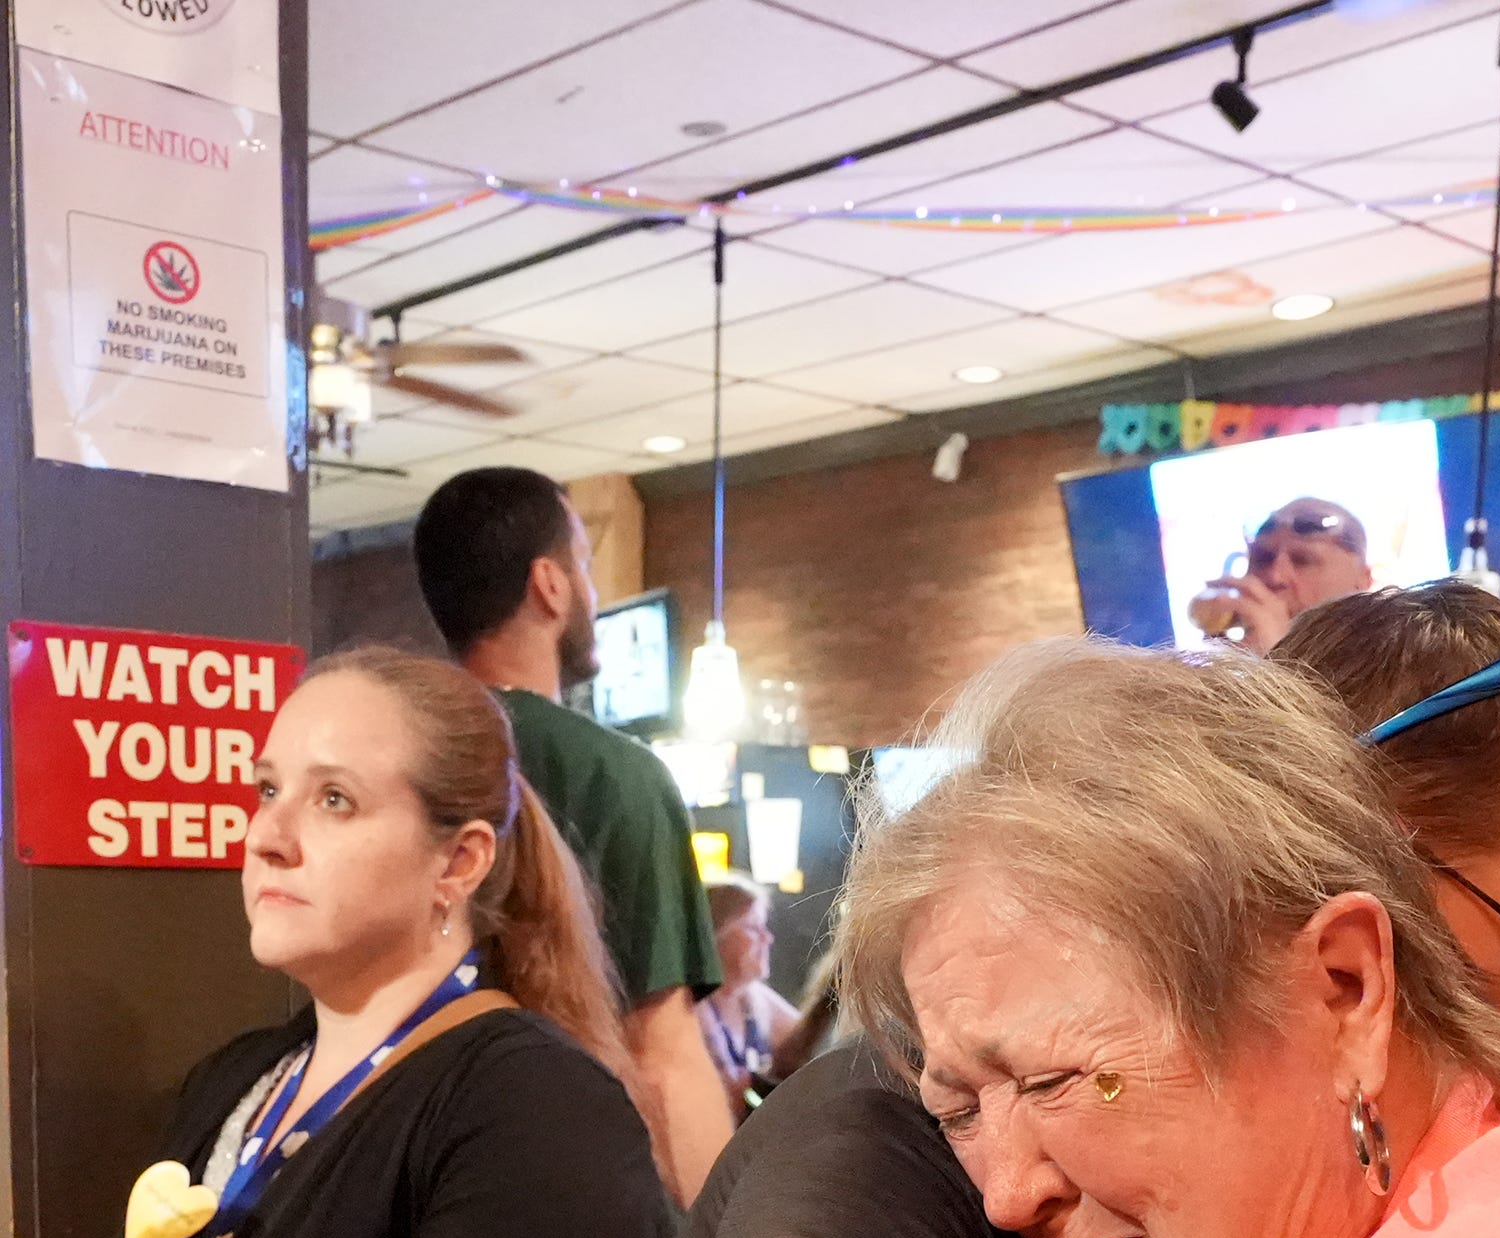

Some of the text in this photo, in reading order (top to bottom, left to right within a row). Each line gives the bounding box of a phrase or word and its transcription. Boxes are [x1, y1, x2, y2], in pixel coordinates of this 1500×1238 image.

[79, 111, 229, 169] ATTENTION
[107, 320, 238, 356] MARIJUANA ON
[117, 300, 227, 333] NO SMOKING
[100, 340, 246, 379] THESE PREMISES
[46, 637, 275, 712] WATCH
[73, 719, 256, 785] YOUR
[87, 799, 248, 859] STEP
